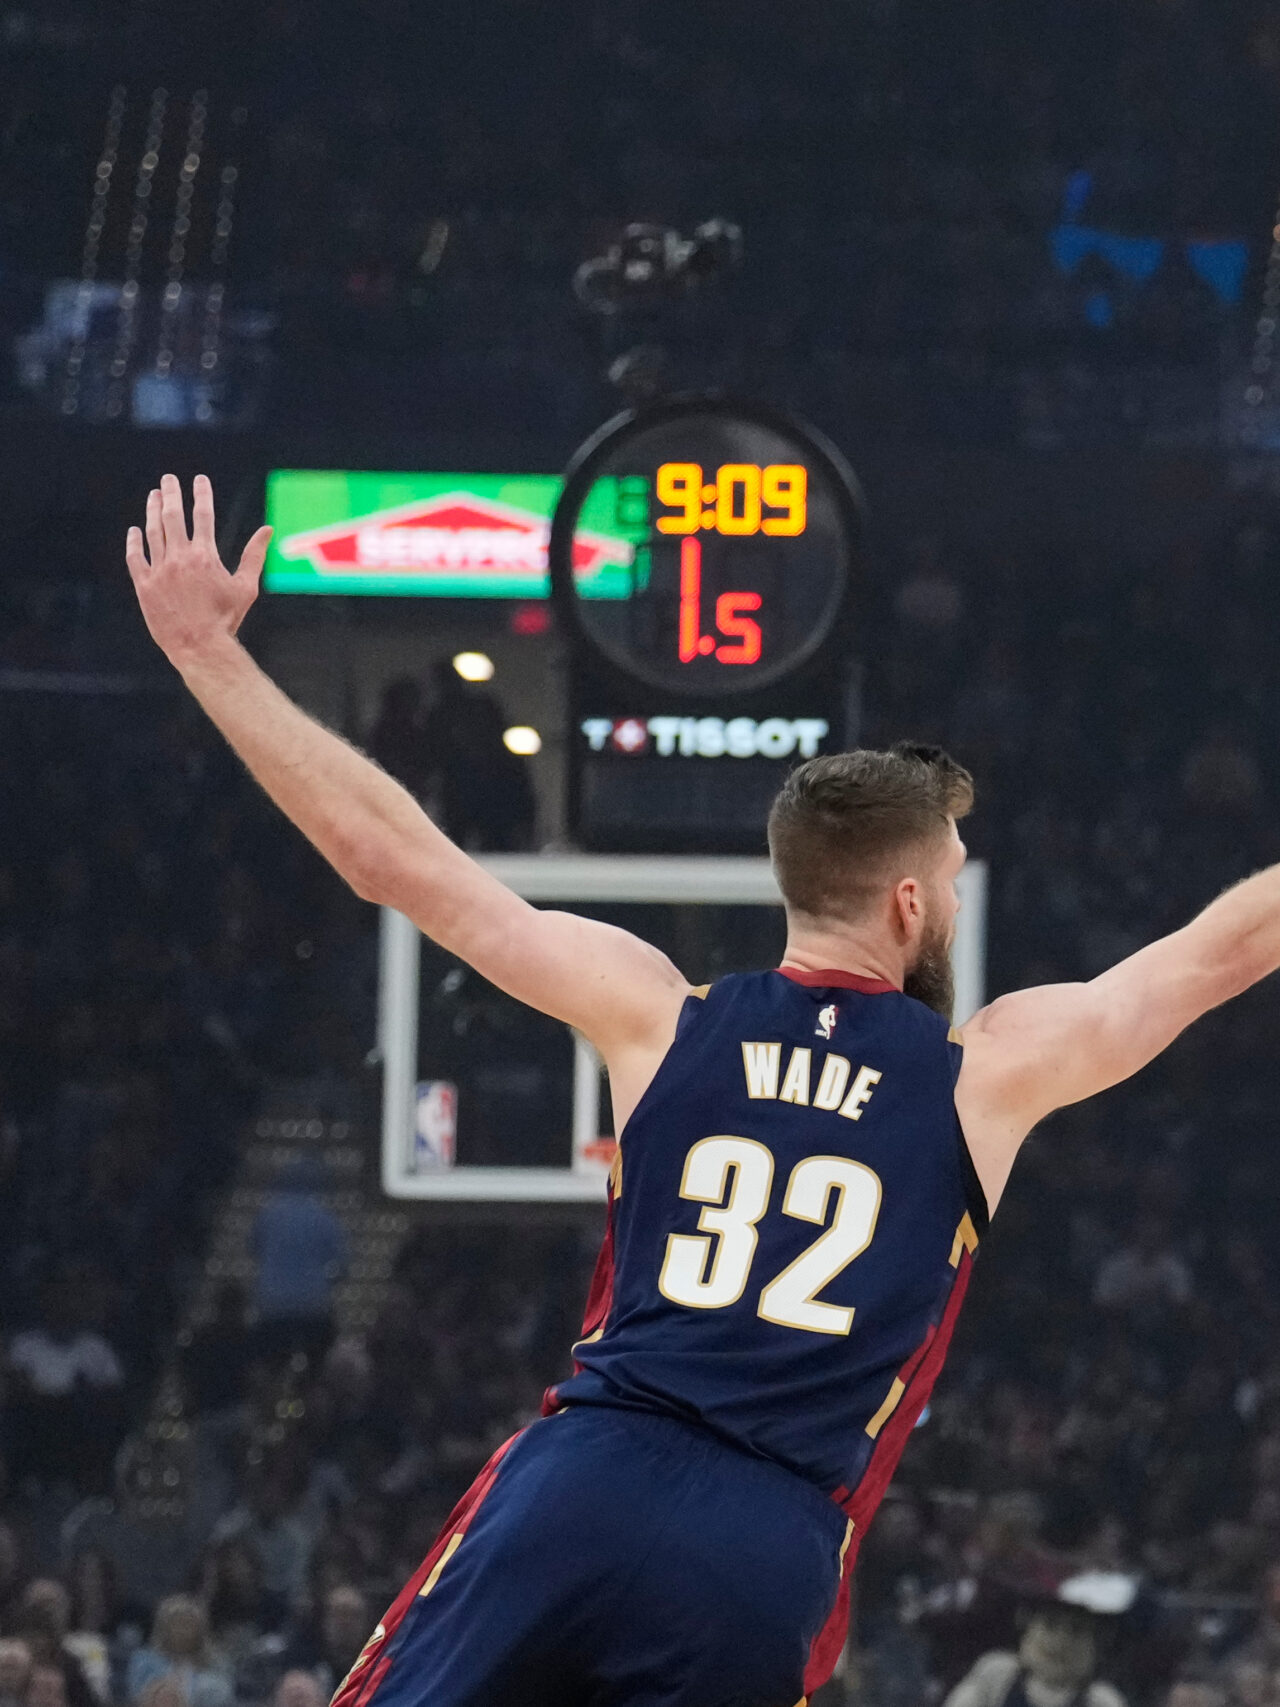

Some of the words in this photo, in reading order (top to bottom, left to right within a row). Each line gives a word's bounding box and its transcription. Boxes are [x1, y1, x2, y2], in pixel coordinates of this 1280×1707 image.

[656, 463, 807, 536] 9:09
[678, 537, 763, 664] 1.5
[648, 717, 829, 758] TISSOT
[741, 1041, 883, 1121] WADE
[658, 1135, 883, 1336] 32
